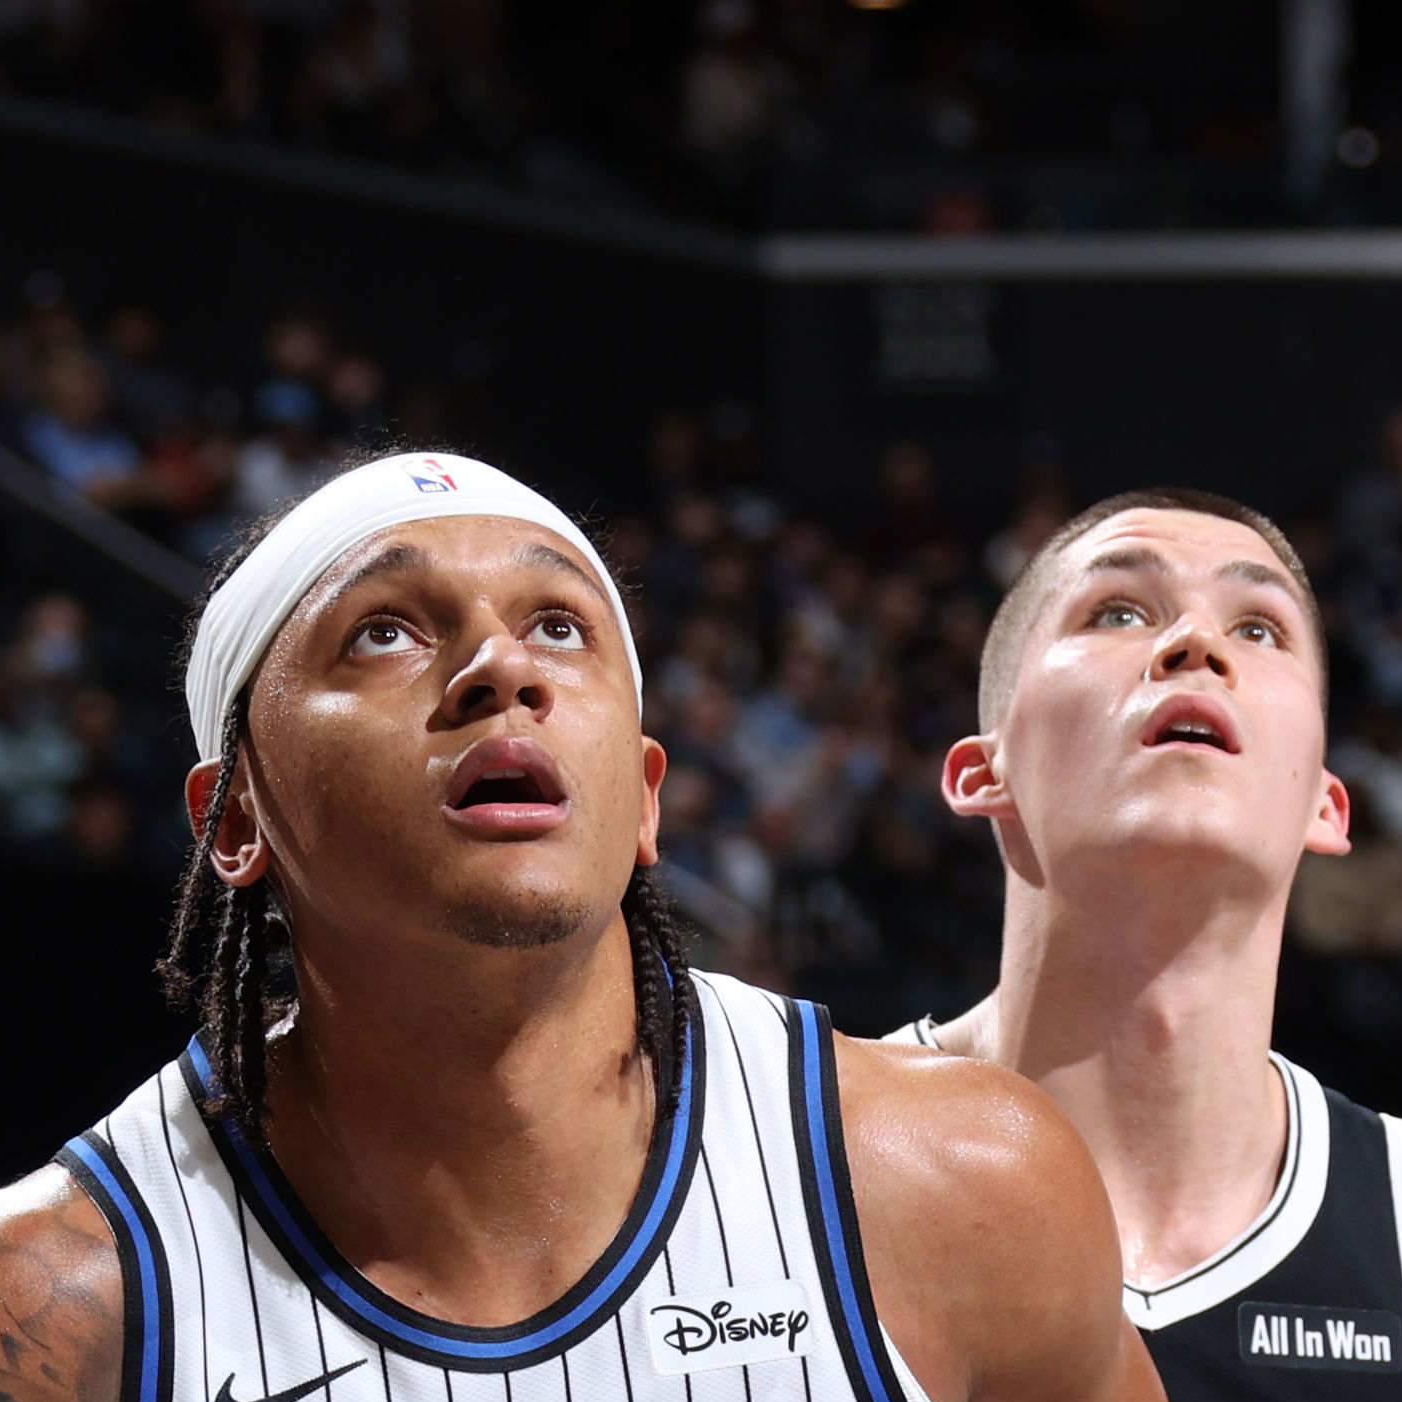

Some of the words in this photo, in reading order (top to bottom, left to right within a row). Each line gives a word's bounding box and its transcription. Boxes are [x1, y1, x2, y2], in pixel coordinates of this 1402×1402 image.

[649, 1300, 810, 1356] Disney
[1251, 1314, 1290, 1356] All
[1295, 1317, 1325, 1358] In
[1326, 1319, 1392, 1362] Won
